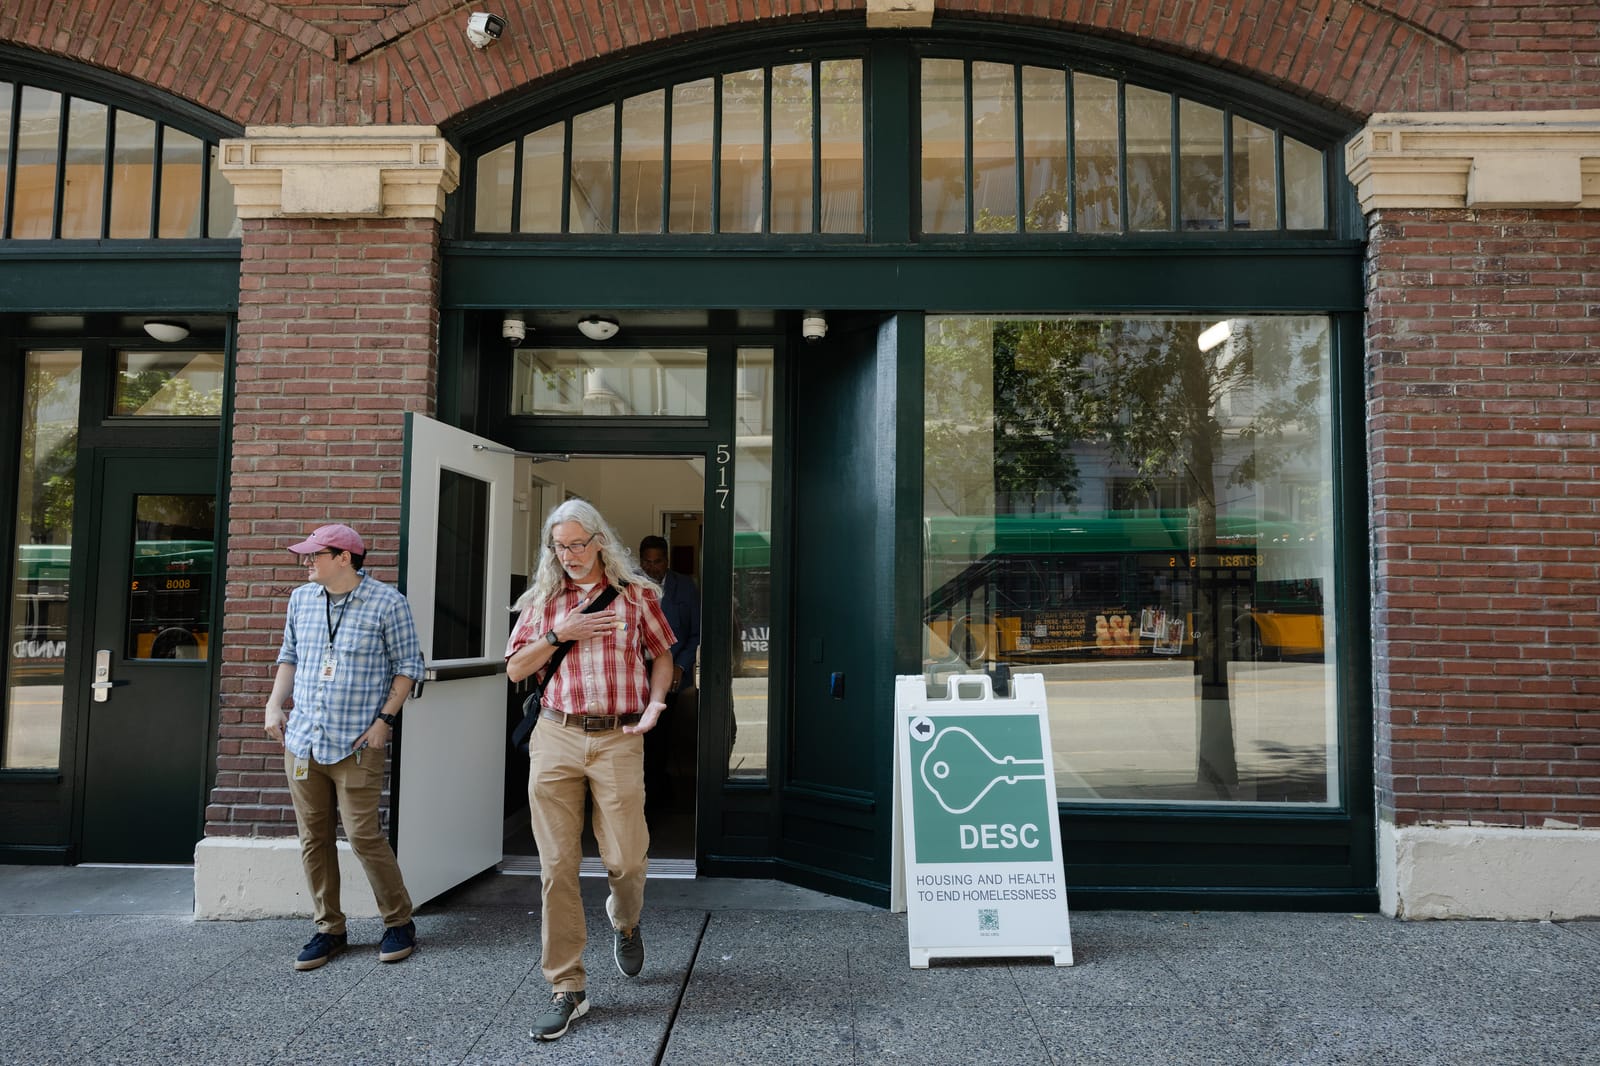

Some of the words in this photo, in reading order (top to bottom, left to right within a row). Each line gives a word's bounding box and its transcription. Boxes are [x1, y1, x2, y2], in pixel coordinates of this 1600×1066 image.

[716, 444, 730, 509] 517
[960, 823, 1040, 849] DESC
[916, 874, 973, 886] HOUSING
[977, 874, 1003, 885] AND
[1008, 873, 1056, 885] HEALTH
[918, 890, 934, 901] TO
[936, 890, 961, 901] END
[962, 889, 1057, 901] HOMELESSNESS
